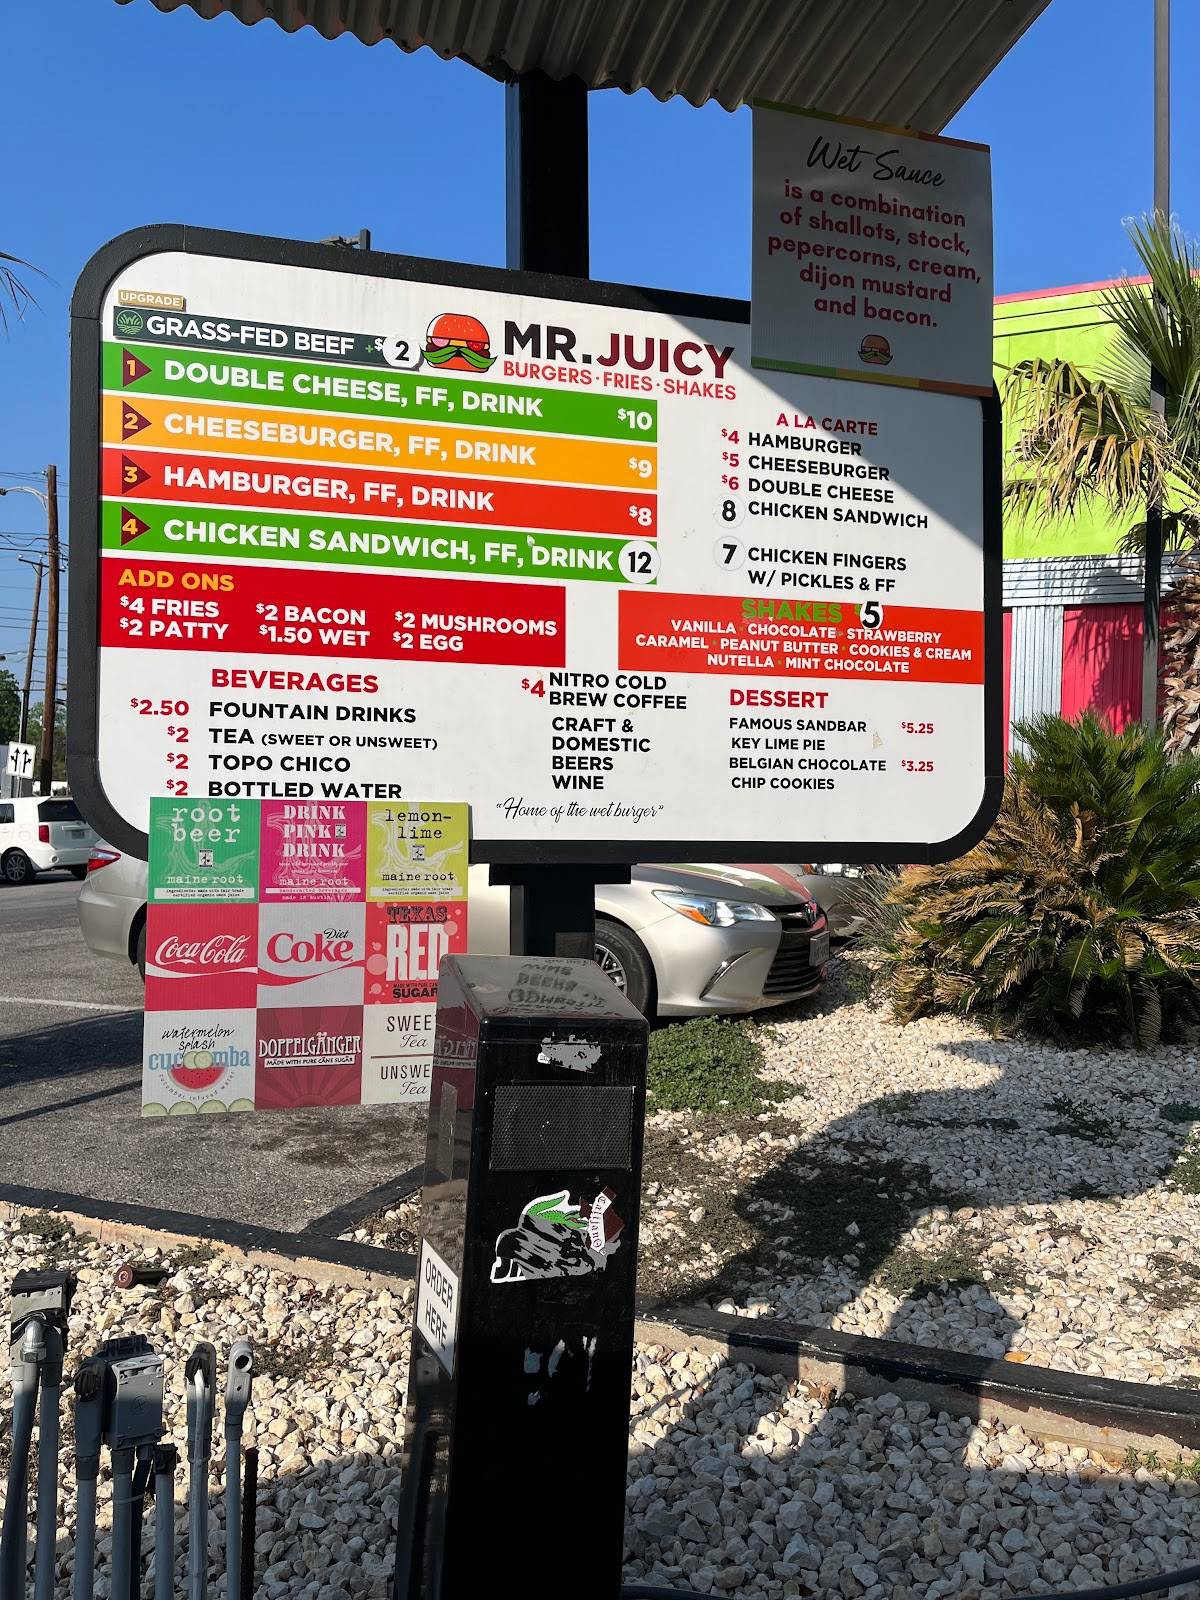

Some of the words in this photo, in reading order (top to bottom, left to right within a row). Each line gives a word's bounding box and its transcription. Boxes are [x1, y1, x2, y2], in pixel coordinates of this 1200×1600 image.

[807, 136, 872, 172] Wet
[873, 150, 945, 186] Sauce
[784, 179, 803, 199] is
[810, 189, 824, 203] a
[831, 193, 966, 227] combination
[779, 206, 802, 225] of
[809, 211, 901, 246] shallots,
[908, 230, 970, 256] stock,
[768, 236, 902, 272] pepercorns,
[908, 257, 982, 284] cream,
[799, 262, 855, 291] dijon
[862, 275, 951, 303] mustard
[119, 292, 182, 307] UPGRADE
[814, 296, 856, 316] and
[863, 297, 937, 327] bacon.
[146, 316, 288, 348] GRASS-FED
[294, 331, 355, 355] BEEF
[503, 359, 592, 385] BURGERS
[603, 372, 653, 392] FRIES
[663, 378, 737, 400] SHAKES
[127, 360, 136, 376] 1
[164, 360, 285, 391] DOUBLE
[292, 374, 408, 408] CHEESE,
[415, 386, 455, 404] FF,
[463, 390, 543, 418] DRINK
[617, 408, 653, 430] $10
[776, 413, 789, 427] A
[794, 415, 817, 429] LA
[821, 417, 878, 436] CARTE
[124, 413, 138, 430] 2
[164, 413, 400, 457] CHEESEBURGER,
[408, 435, 447, 461] FF,
[455, 439, 537, 466] DRINK
[629, 457, 653, 478] $9
[721, 429, 740, 444] $4
[748, 432, 862, 456] HAMBURGER
[722, 452, 740, 467] $5
[748, 455, 890, 481] CHEESEBURGER
[124, 466, 138, 483] 3
[164, 465, 356, 504] HAMBURGER,
[411, 485, 495, 511] DRINK
[629, 505, 652, 526] $8
[721, 474, 740, 491] $6
[748, 478, 822, 498] DOUBLE
[827, 485, 894, 503] CHEESE
[722, 500, 736, 521] 8
[748, 501, 828, 520] CHICKEN
[833, 508, 928, 528] SANDWICH
[122, 519, 138, 535] 4
[164, 519, 300, 549] CHICKEN
[308, 529, 477, 565] SANDWICH,
[532, 546, 614, 571] DRINK
[628, 552, 652, 574] 12
[722, 543, 738, 564] 7
[748, 547, 828, 566] CHICKEN
[833, 552, 907, 571] FINGERS
[118, 568, 174, 588] ADD
[182, 572, 235, 592] ONS
[748, 570, 776, 587] W/
[781, 572, 854, 590] PICKLES
[876, 578, 896, 592] FF
[120, 596, 144, 614] $4
[151, 598, 219, 617] FRIES
[256, 602, 278, 621] $2
[285, 606, 366, 625] BACON
[742, 599, 843, 624] SHAKES
[120, 617, 143, 636] $2
[151, 620, 229, 640] PATTY
[395, 611, 416, 629] $2
[421, 613, 557, 636] MUSHROOMS
[671, 619, 736, 635] VANILLA
[748, 623, 837, 640] CHOCOLATE
[847, 627, 942, 645] STRAWBERRY
[259, 625, 313, 645] $1.50
[319, 629, 370, 646] WET
[393, 632, 414, 649] $2
[420, 634, 464, 652] EGG
[635, 634, 709, 649] CARAMEL
[720, 638, 779, 653] PEANUT
[783, 641, 839, 655] BUTTER
[849, 643, 910, 659] COOKIES
[925, 647, 972, 661] CREAM
[707, 654, 774, 668] NUTELLA
[785, 656, 821, 670] MINT
[824, 658, 910, 673] CHOCOLATE
[211, 669, 379, 693] BEVERAGES
[521, 678, 546, 698] $4
[549, 672, 610, 689] NITRO
[615, 675, 667, 690] COLD
[549, 691, 608, 707] BREW
[613, 694, 687, 710] COFFEE
[729, 689, 829, 709] DESSERT
[130, 698, 190, 716] $2.50
[209, 701, 329, 721] FOUNTAIN
[336, 706, 417, 723] DRINKS
[552, 717, 617, 733] CRAFT
[729, 718, 793, 731] FAMOUS
[796, 719, 867, 733] SANDBAR
[901, 721, 934, 735] $5.25
[167, 725, 189, 743] $2
[209, 728, 255, 745] TEA
[261, 733, 324, 747] (SWEET
[329, 735, 352, 747] OR
[356, 736, 438, 751] UNSWEET)
[552, 737, 651, 752] DOMESTIC
[731, 738, 762, 750] KEY
[765, 738, 799, 751] LIME
[803, 740, 826, 751] PIE
[209, 754, 273, 771] TOPO
[280, 756, 351, 773] CHICO
[552, 756, 614, 771] BEERS
[729, 757, 796, 771] BELGIAN
[799, 758, 887, 772] CHOCOLATE
[901, 759, 934, 773] $3.25
[208, 781, 314, 798] BOTTLED
[321, 783, 402, 799] WATER
[552, 775, 604, 790] WINE
[731, 777, 767, 789] CHIP
[770, 778, 835, 790] COOKIES
[171, 803, 241, 823] root
[283, 805, 345, 820] DRINK
[385, 809, 451, 823] lemon-
[550, 804, 565, 823] of
[566, 802, 588, 817] the
[590, 803, 614, 817] wet
[171, 823, 240, 843] beer
[283, 824, 331, 839] PINK
[398, 826, 443, 839] lime
[283, 843, 345, 858] DRINK
[167, 874, 208, 885] maine
[212, 874, 244, 884] root
[319, 876, 349, 886] root
[382, 872, 421, 882] maine
[425, 871, 455, 881] root
[387, 905, 448, 923] TEXAS
[323, 928, 350, 940] Diet
[266, 932, 354, 964] Coke
[386, 923, 448, 981] RED
[161, 1023, 235, 1039] watermelon
[400, 1033, 428, 1048] Tea
[178, 1036, 216, 1058] splash
[400, 1081, 428, 1096] Tea
[425, 1257, 453, 1312] ORDER
[425, 1299, 448, 1351] HERE
